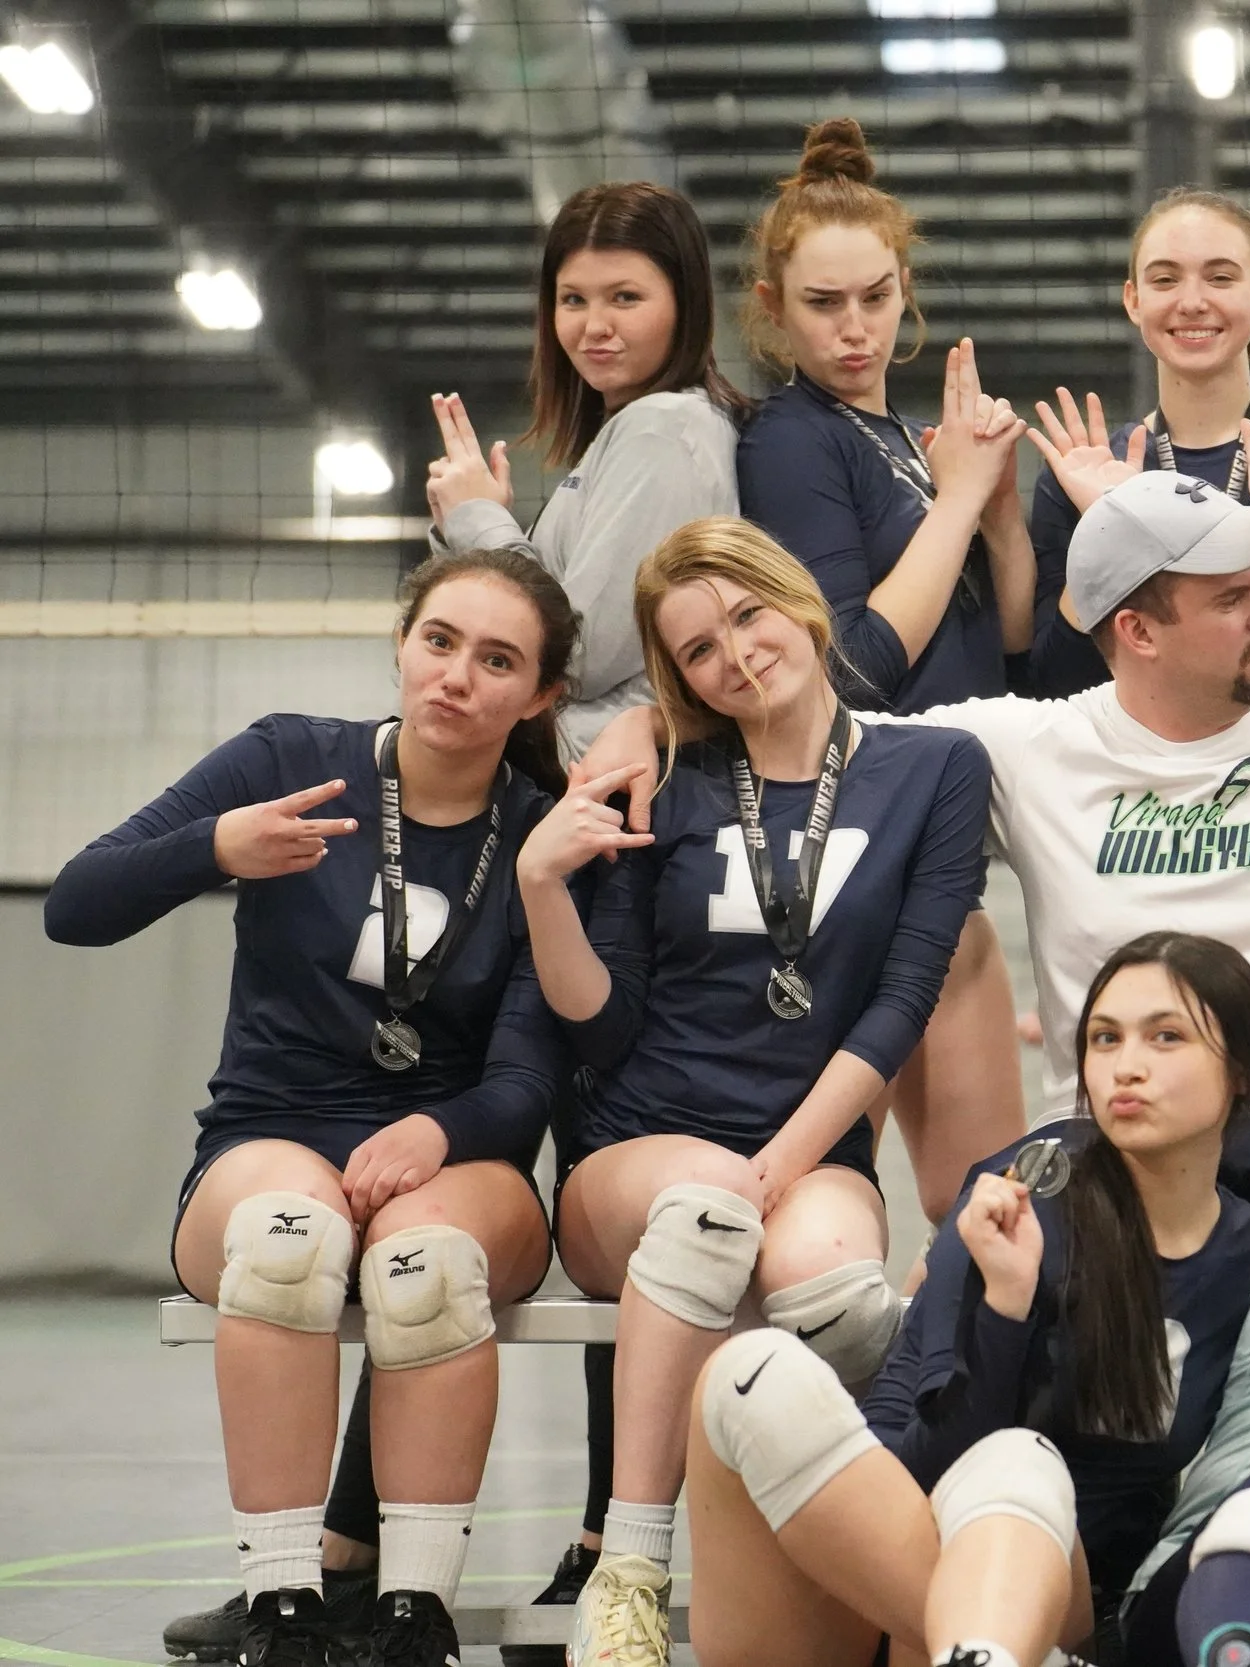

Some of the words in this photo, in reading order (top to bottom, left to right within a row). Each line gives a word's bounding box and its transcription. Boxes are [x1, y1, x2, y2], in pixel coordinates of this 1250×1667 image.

[382, 777, 403, 890] RUNNER-UP
[808, 742, 840, 845] RUNNER-UP
[1110, 789, 1227, 838] Virago
[464, 803, 501, 910] RUNNER-UP
[708, 823, 870, 937] 17
[346, 872, 450, 992] 2
